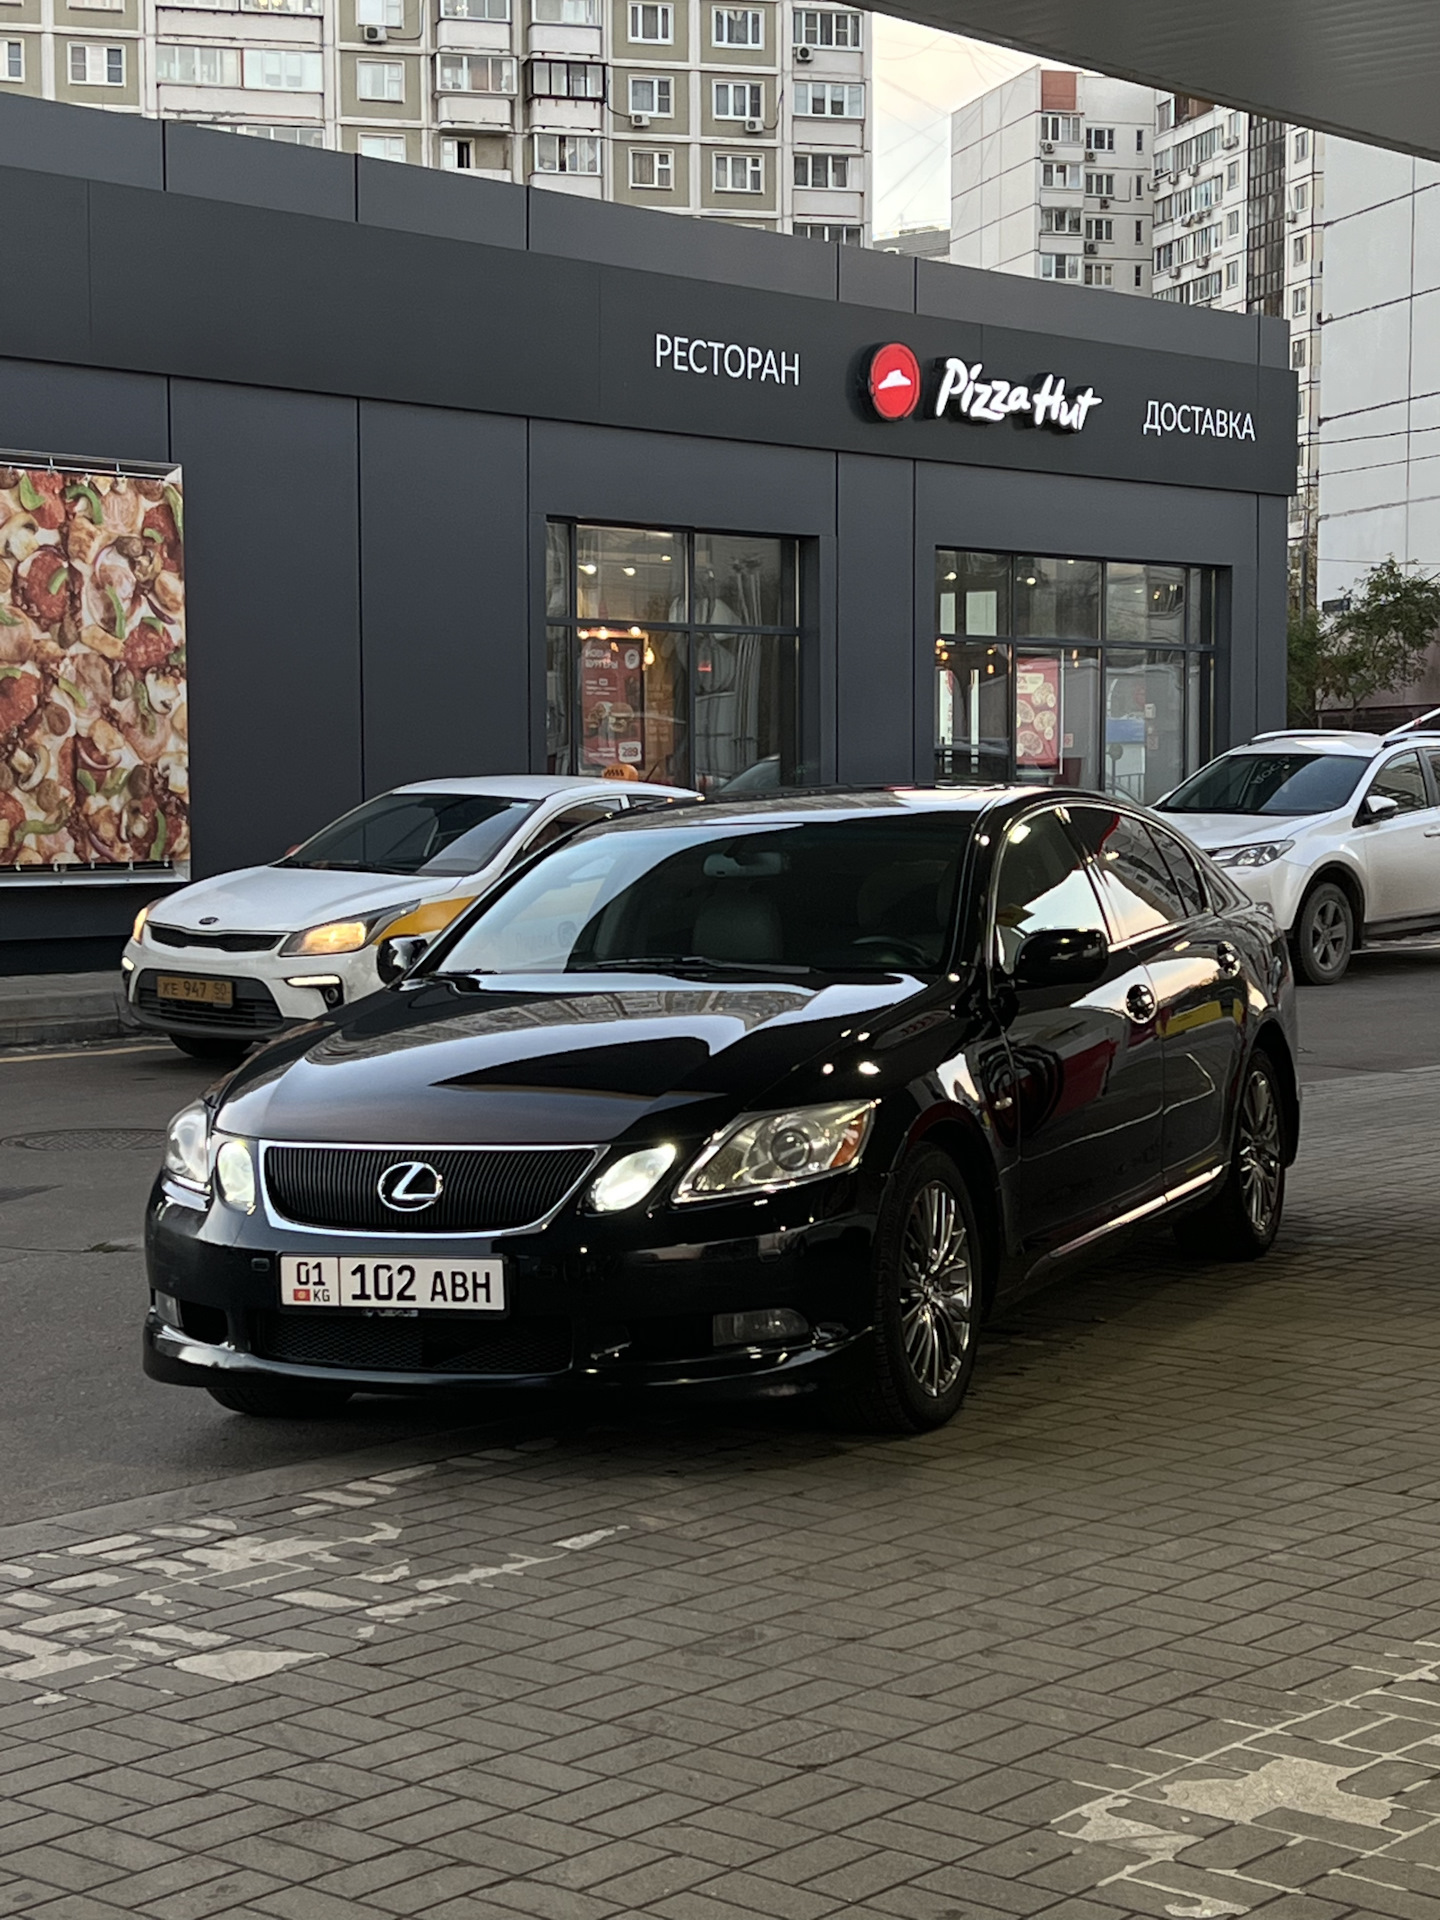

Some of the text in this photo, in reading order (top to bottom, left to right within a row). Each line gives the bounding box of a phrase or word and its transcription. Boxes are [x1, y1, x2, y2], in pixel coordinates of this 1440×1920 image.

[655, 333, 799, 386] РЕСТОРАН
[936, 357, 1103, 431] Pizza Hut
[1143, 399, 1256, 442] ДОСТАВКА
[183, 980, 206, 999] 947
[296, 1261, 326, 1286] 01
[350, 1263, 492, 1303] 102 ABH
[313, 1288, 331, 1302] KG
